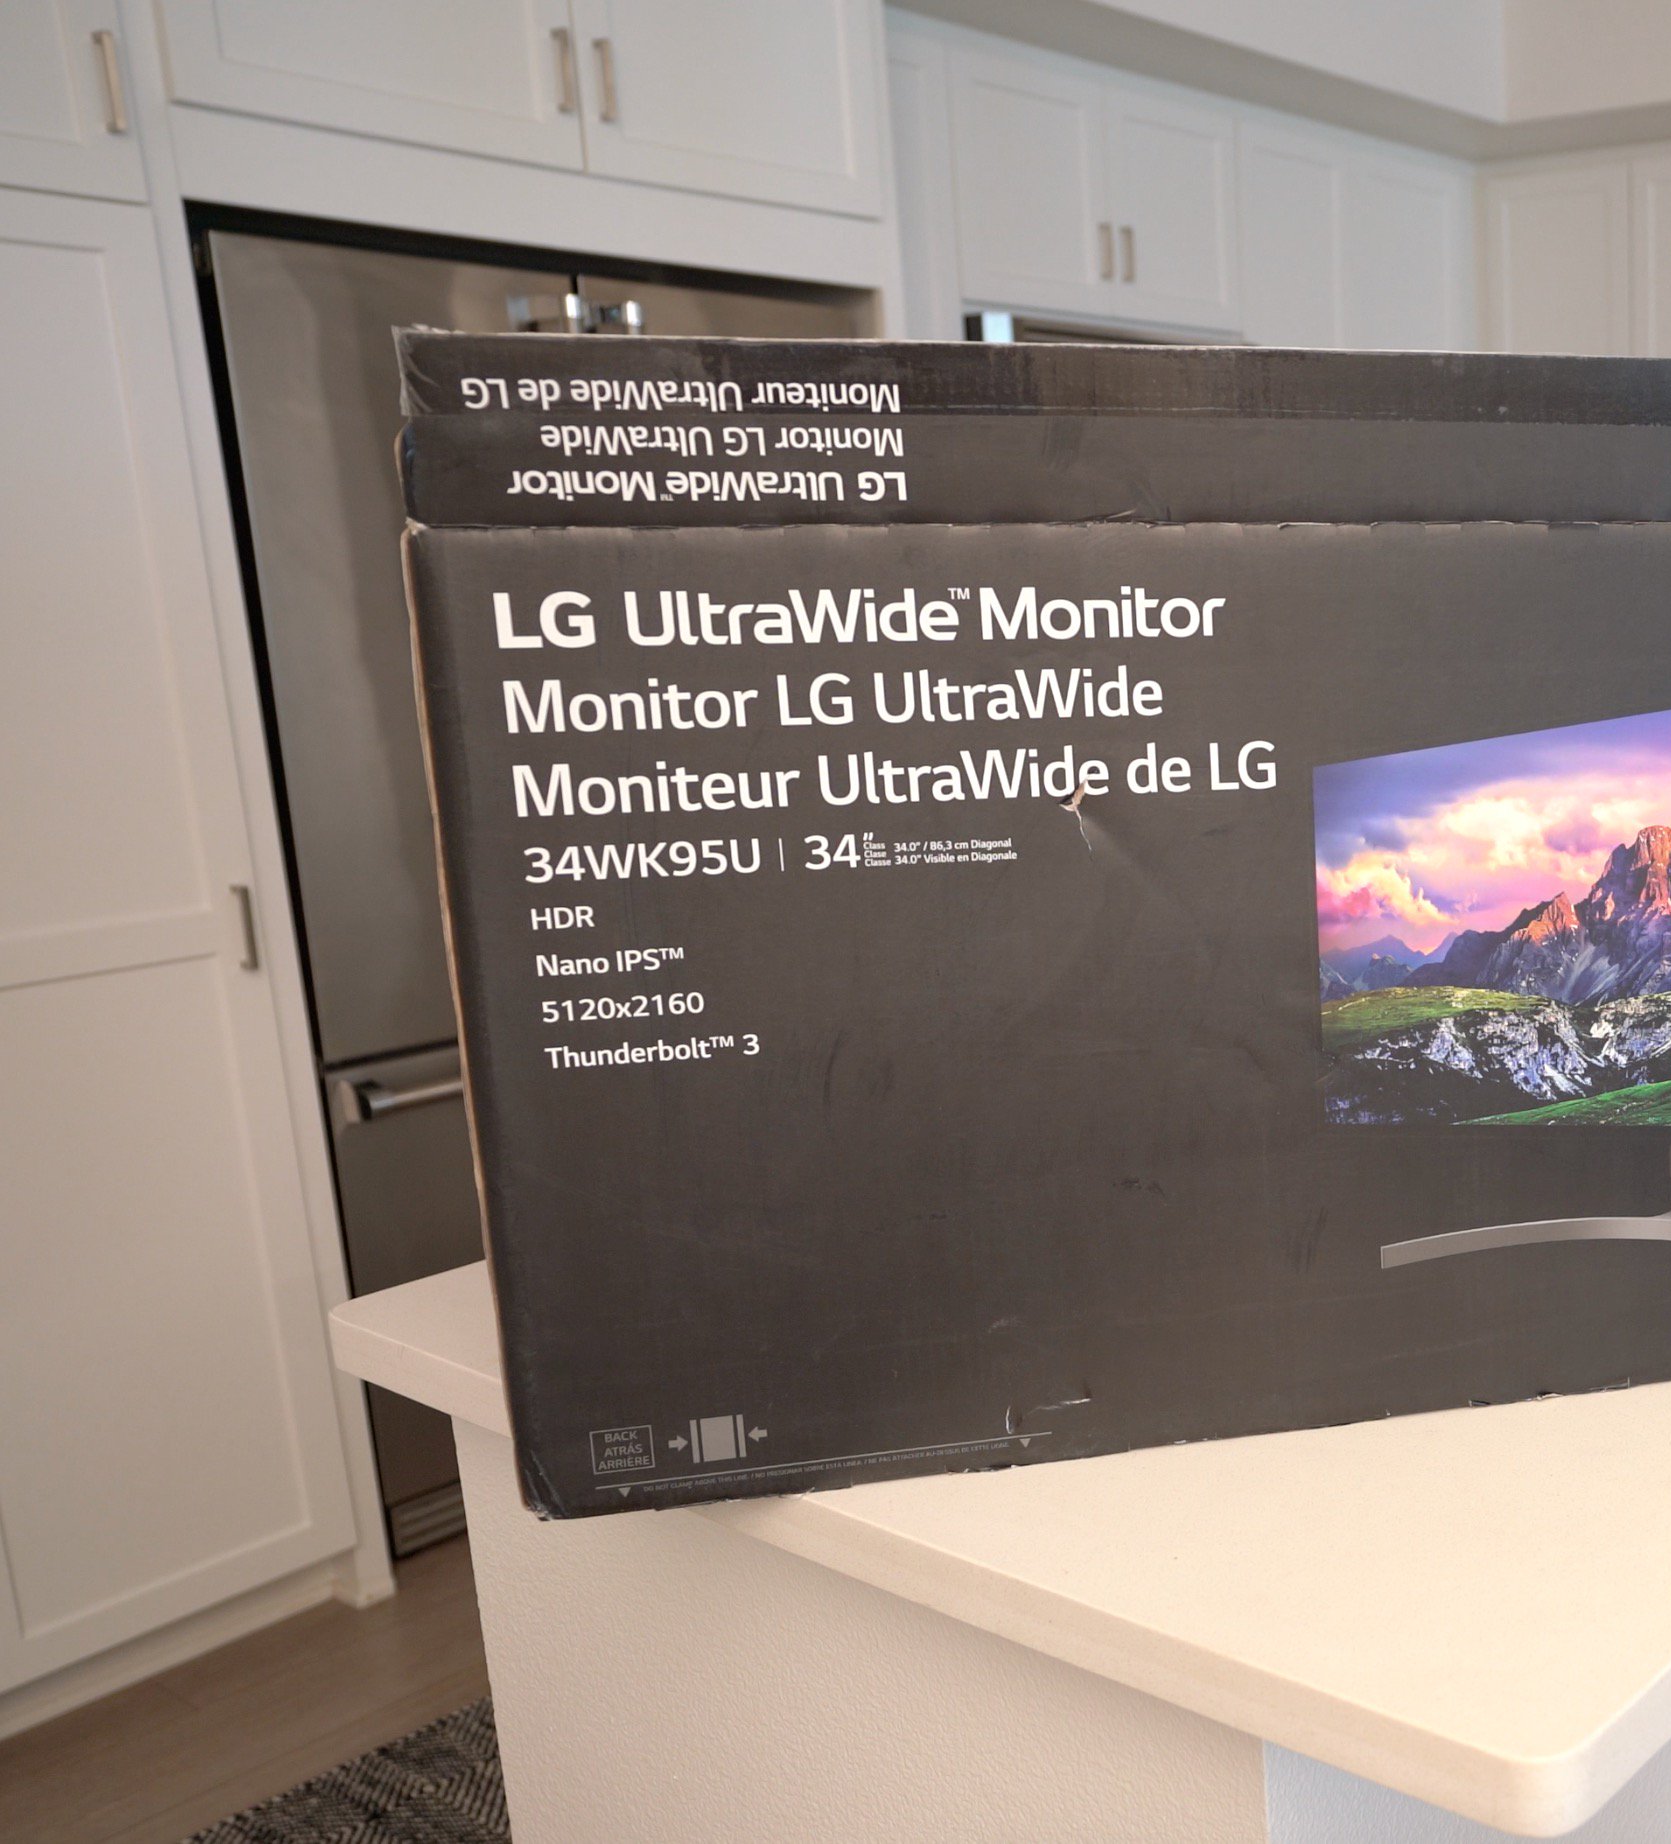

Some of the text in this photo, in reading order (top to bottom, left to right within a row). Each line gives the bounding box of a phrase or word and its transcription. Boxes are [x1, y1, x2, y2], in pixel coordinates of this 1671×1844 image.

[461, 378, 900, 413] Moniteur UltraWide de LG
[541, 425, 903, 457] Monitor LG UltraWide
[507, 471, 656, 501] Monitor
[858, 472, 907, 501] LG
[493, 591, 596, 648] LG
[980, 586, 1226, 640] Monitor
[503, 665, 1162, 733] Monitor LG UltraWide
[513, 741, 1276, 817] Moniteur UltraWide de LG
[863, 842, 886, 850] Class
[864, 850, 887, 858] Clase
[923, 851, 956, 864] Visible
[957, 852, 970, 863] en
[970, 850, 1018, 863] Diagonale
[929, 840, 953, 853] 86,3
[954, 841, 969, 850] cm
[970, 837, 1012, 851] Diagonal
[524, 838, 760, 883] 34WK95U
[864, 858, 892, 867] Classe
[531, 906, 594, 930] HDR
[536, 954, 609, 976] Nano
[542, 992, 704, 1022] 5120x2160
[743, 1034, 759, 1055] 3
[604, 1430, 638, 1444] BACK
